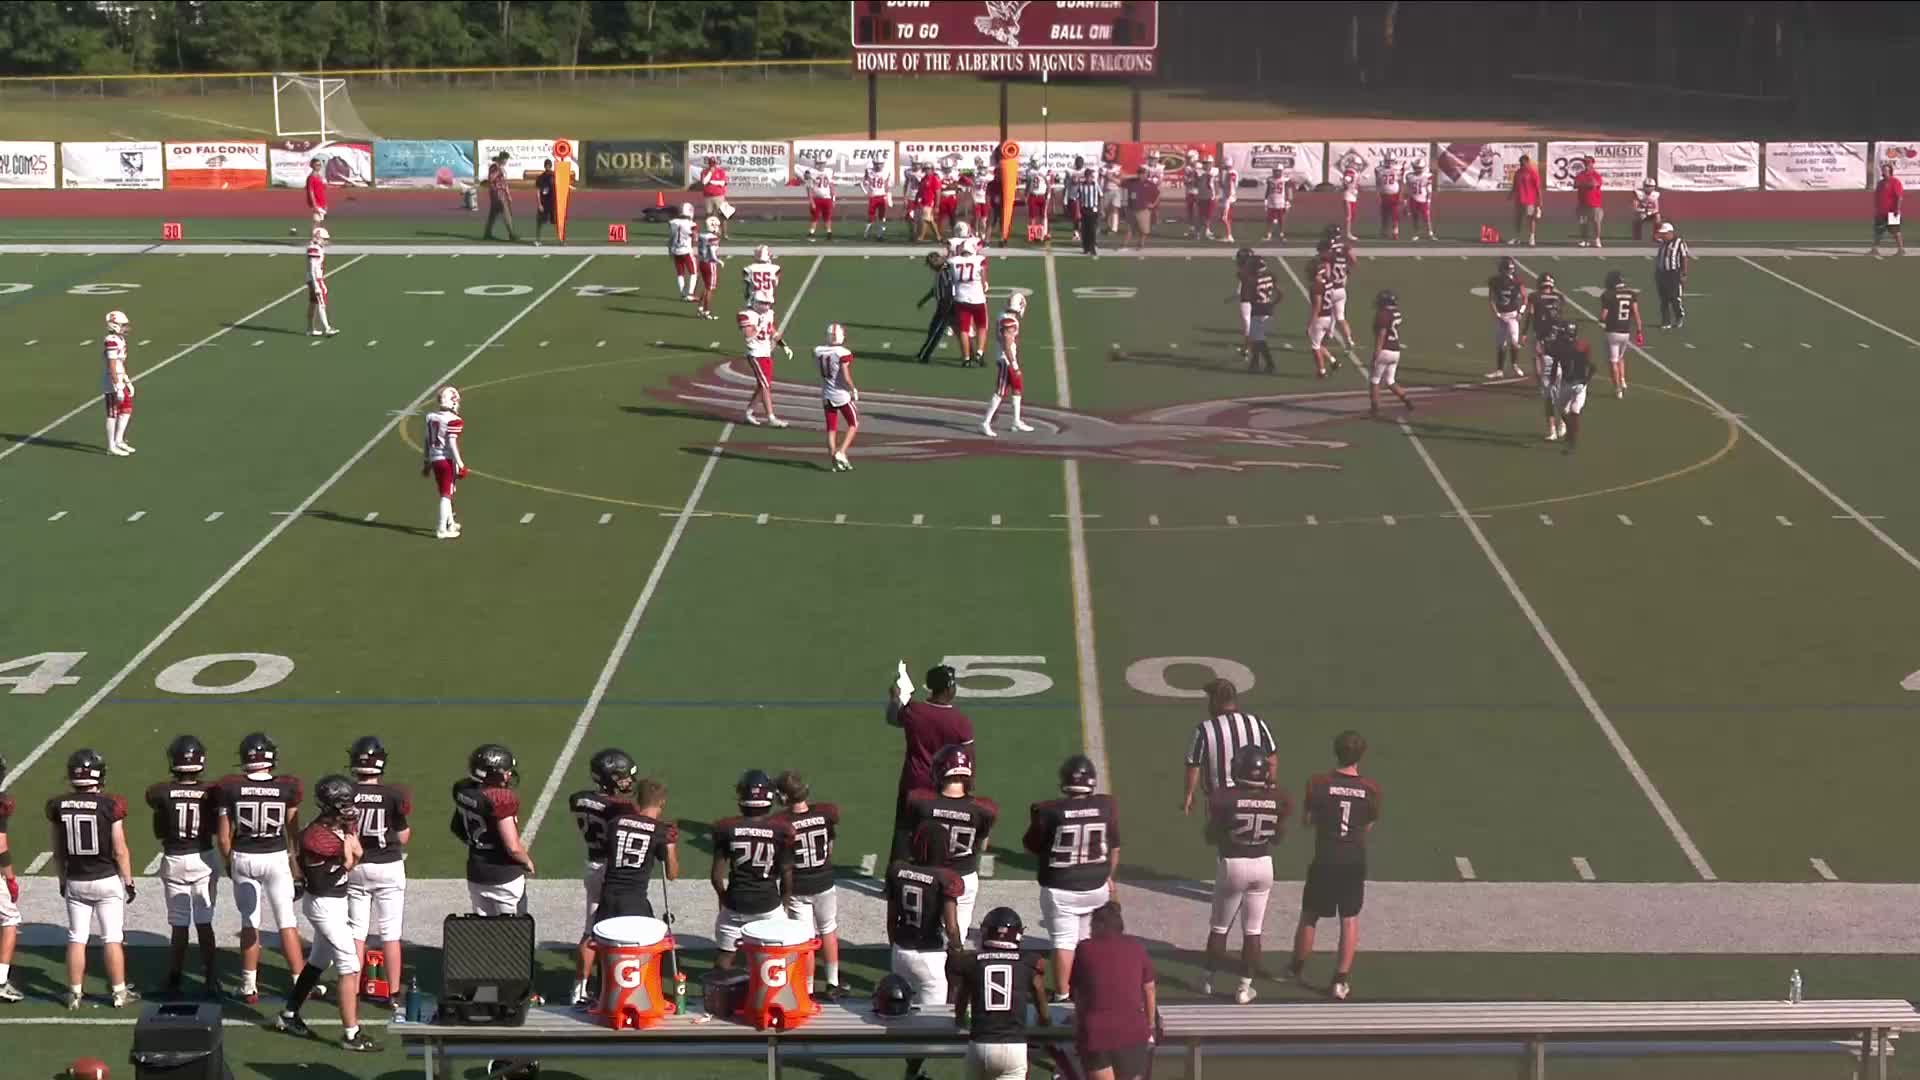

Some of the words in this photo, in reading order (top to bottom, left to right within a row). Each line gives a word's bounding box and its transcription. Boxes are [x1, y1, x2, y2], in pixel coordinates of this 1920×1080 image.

[897, 24, 914, 38] TO
[919, 24, 939, 38] GO
[1051, 25, 1083, 40] BALL
[1089, 25, 1112, 40] ON
[857, 53, 897, 70] HOME
[902, 53, 920, 70] OF
[924, 53, 951, 70] THE
[956, 53, 1024, 71] ALBERTUS
[1029, 54, 1085, 71] MAGNUS
[1090, 54, 1153, 71] FALCONS
[173, 147, 192, 155] GO
[693, 144, 748, 154] SPARKY'S
[751, 145, 785, 155] DINER
[906, 144, 925, 152] GO
[929, 144, 994, 153] FALCONS!
[1594, 145, 1643, 158] MAJESTIC
[595, 152, 674, 169] NOBLE
[165, 224, 179, 239] 30
[609, 226, 625, 240] 40
[752, 271, 771, 291] 55
[955, 262, 974, 282] 77
[1618, 300, 1630, 320] 6
[175, 803, 200, 838] 11
[61, 814, 100, 855] 10
[615, 830, 652, 869] 19
[795, 828, 829, 869] 30
[1048, 823, 1108, 868] 90
[902, 884, 923, 928] 9
[614, 959, 641, 989] G
[760, 958, 787, 988] G
[984, 964, 1013, 1011] 8
